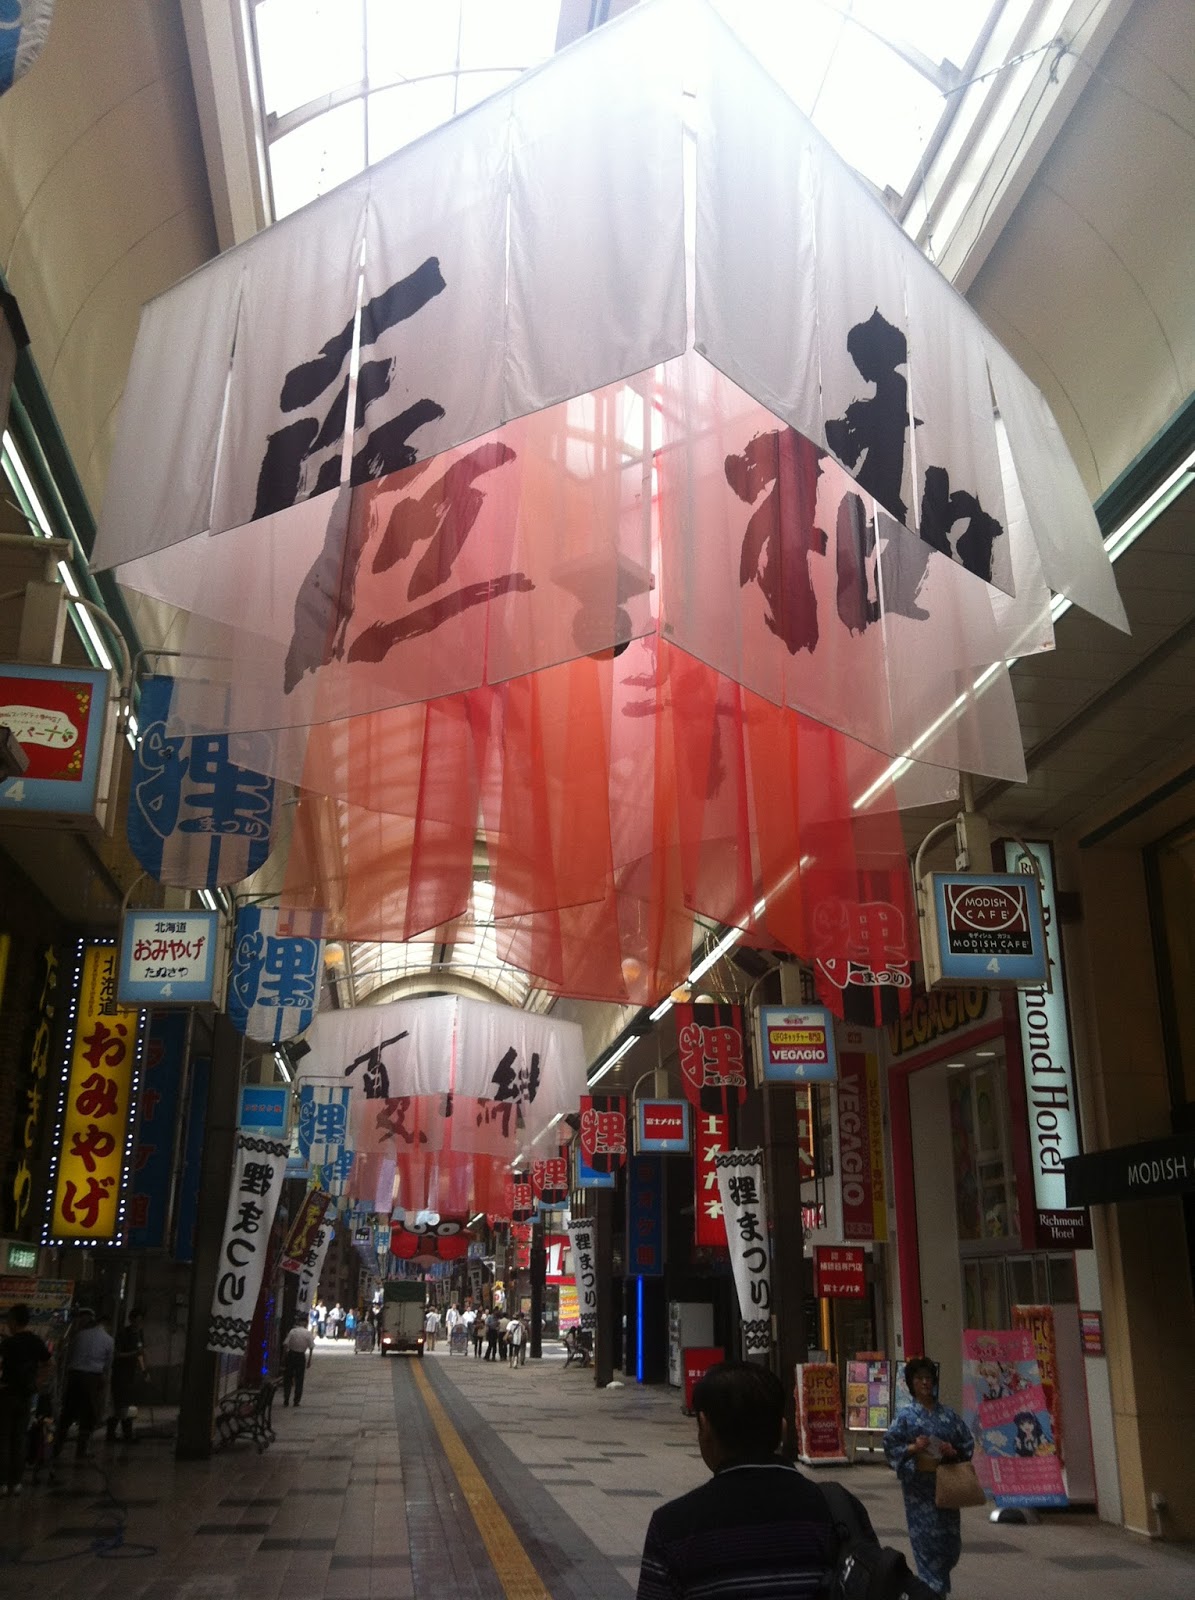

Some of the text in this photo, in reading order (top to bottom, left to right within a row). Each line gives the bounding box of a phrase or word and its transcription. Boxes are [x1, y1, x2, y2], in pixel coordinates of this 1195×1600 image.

[5, 781, 26, 801] 4
[965, 897, 1007, 908] MODISH
[154, 922, 187, 933] 北海道
[134, 936, 206, 961] おみやげ
[953, 940, 997, 948] MODISH
[144, 967, 189, 978] たぬきや
[234, 930, 316, 1009] 狸
[985, 958, 1000, 973] 4
[863, 971, 904, 985] まつり
[160, 983, 173, 997] 4
[888, 985, 989, 1056] VEGAGIO
[679, 1022, 747, 1089] 狸
[771, 1049, 825, 1061] VEGAGIO
[794, 1065, 805, 1076] 4
[61, 1021, 127, 1229] おみやげ
[645, 1117, 682, 1126] 富士メガネ
[580, 1107, 627, 1155] 狸
[1031, 1084, 1069, 1176] Hotel
[660, 1140, 667, 1148] 4
[839, 1073, 865, 1207] VEGAGIO
[1127, 1157, 1187, 1186] MODISH
[1039, 1213, 1083, 1227] Richmond
[1051, 1226, 1075, 1239] Hotel
[729, 1175, 770, 1310] 狸まつり
[575, 1232, 597, 1308] 狸まつり
[823, 1284, 861, 1293] 富士メガネ
